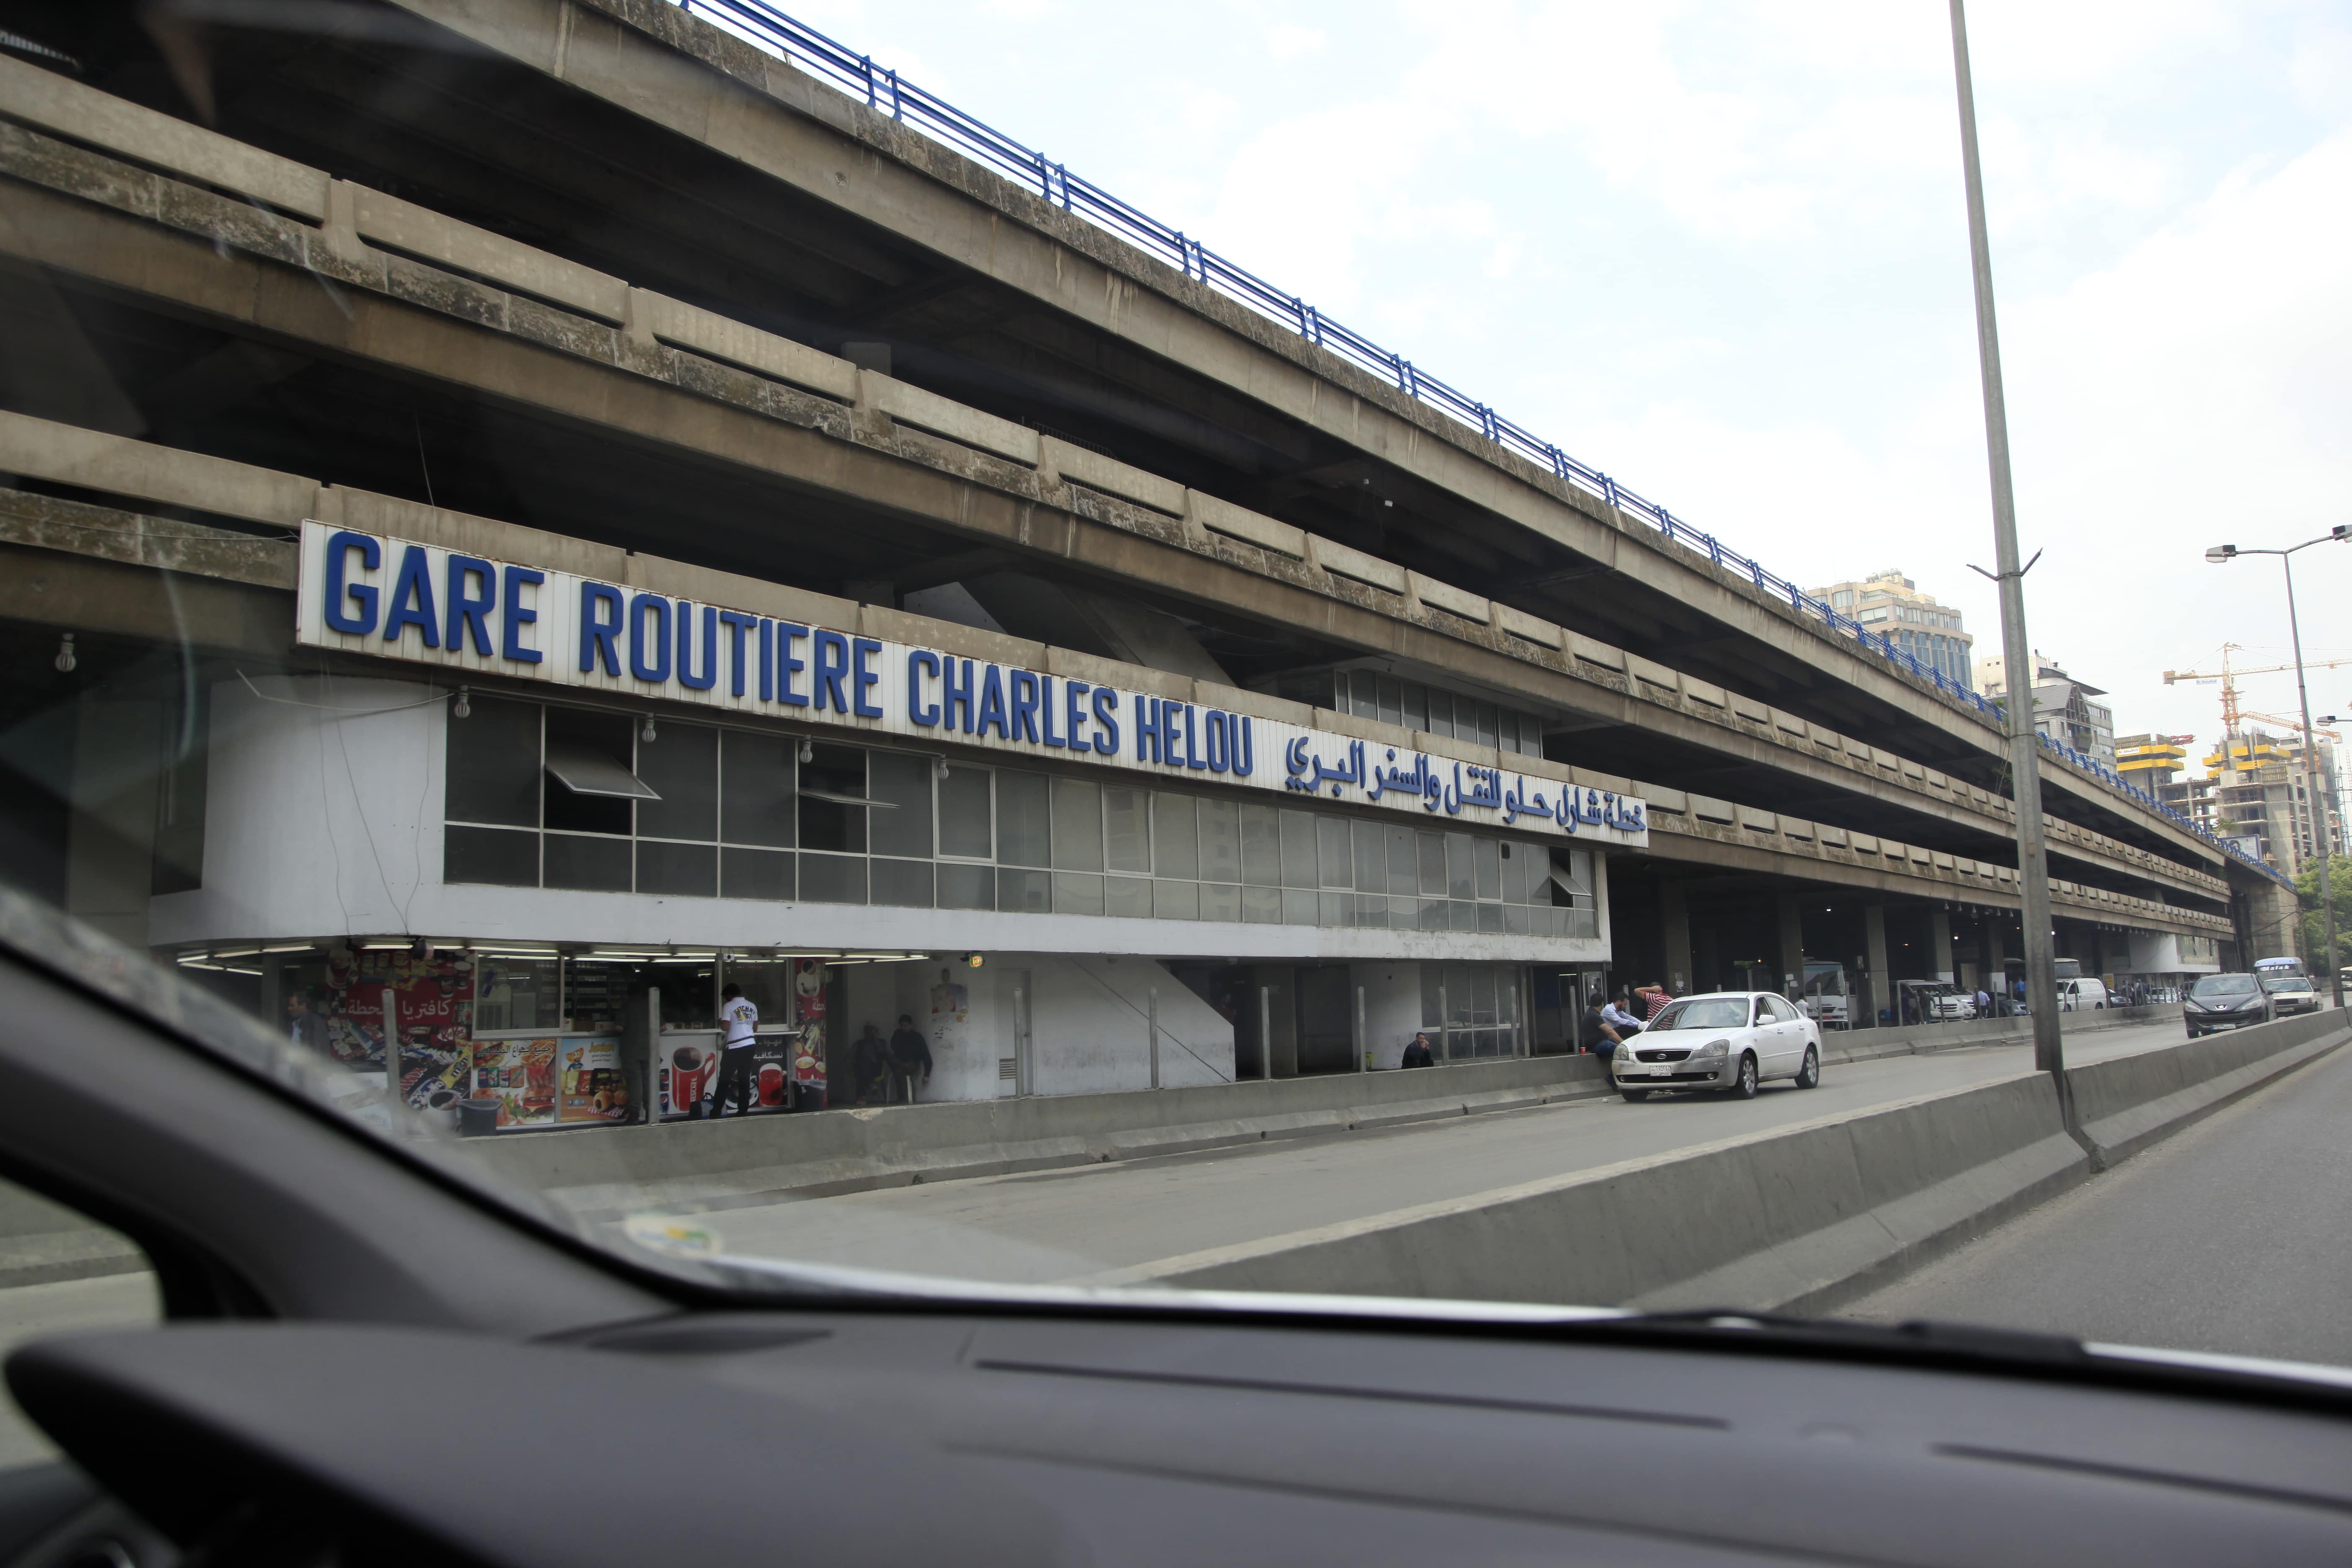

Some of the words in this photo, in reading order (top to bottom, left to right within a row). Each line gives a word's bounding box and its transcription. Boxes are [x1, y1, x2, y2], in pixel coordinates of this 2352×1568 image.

[324, 531, 545, 663] GARE
[579, 581, 883, 718] ROUTIERE
[908, 650, 1119, 755] CHARLES
[1136, 695, 1253, 776] HELOU
[1285, 736, 1366, 797] البري
[1367, 748, 1441, 811] والسفر
[1445, 762, 1502, 814] للنقل
[1502, 775, 1554, 823] حلو
[1556, 784, 1602, 833] شارل
[1604, 792, 1646, 831] محطة
[348, 999, 384, 1014] حطة
